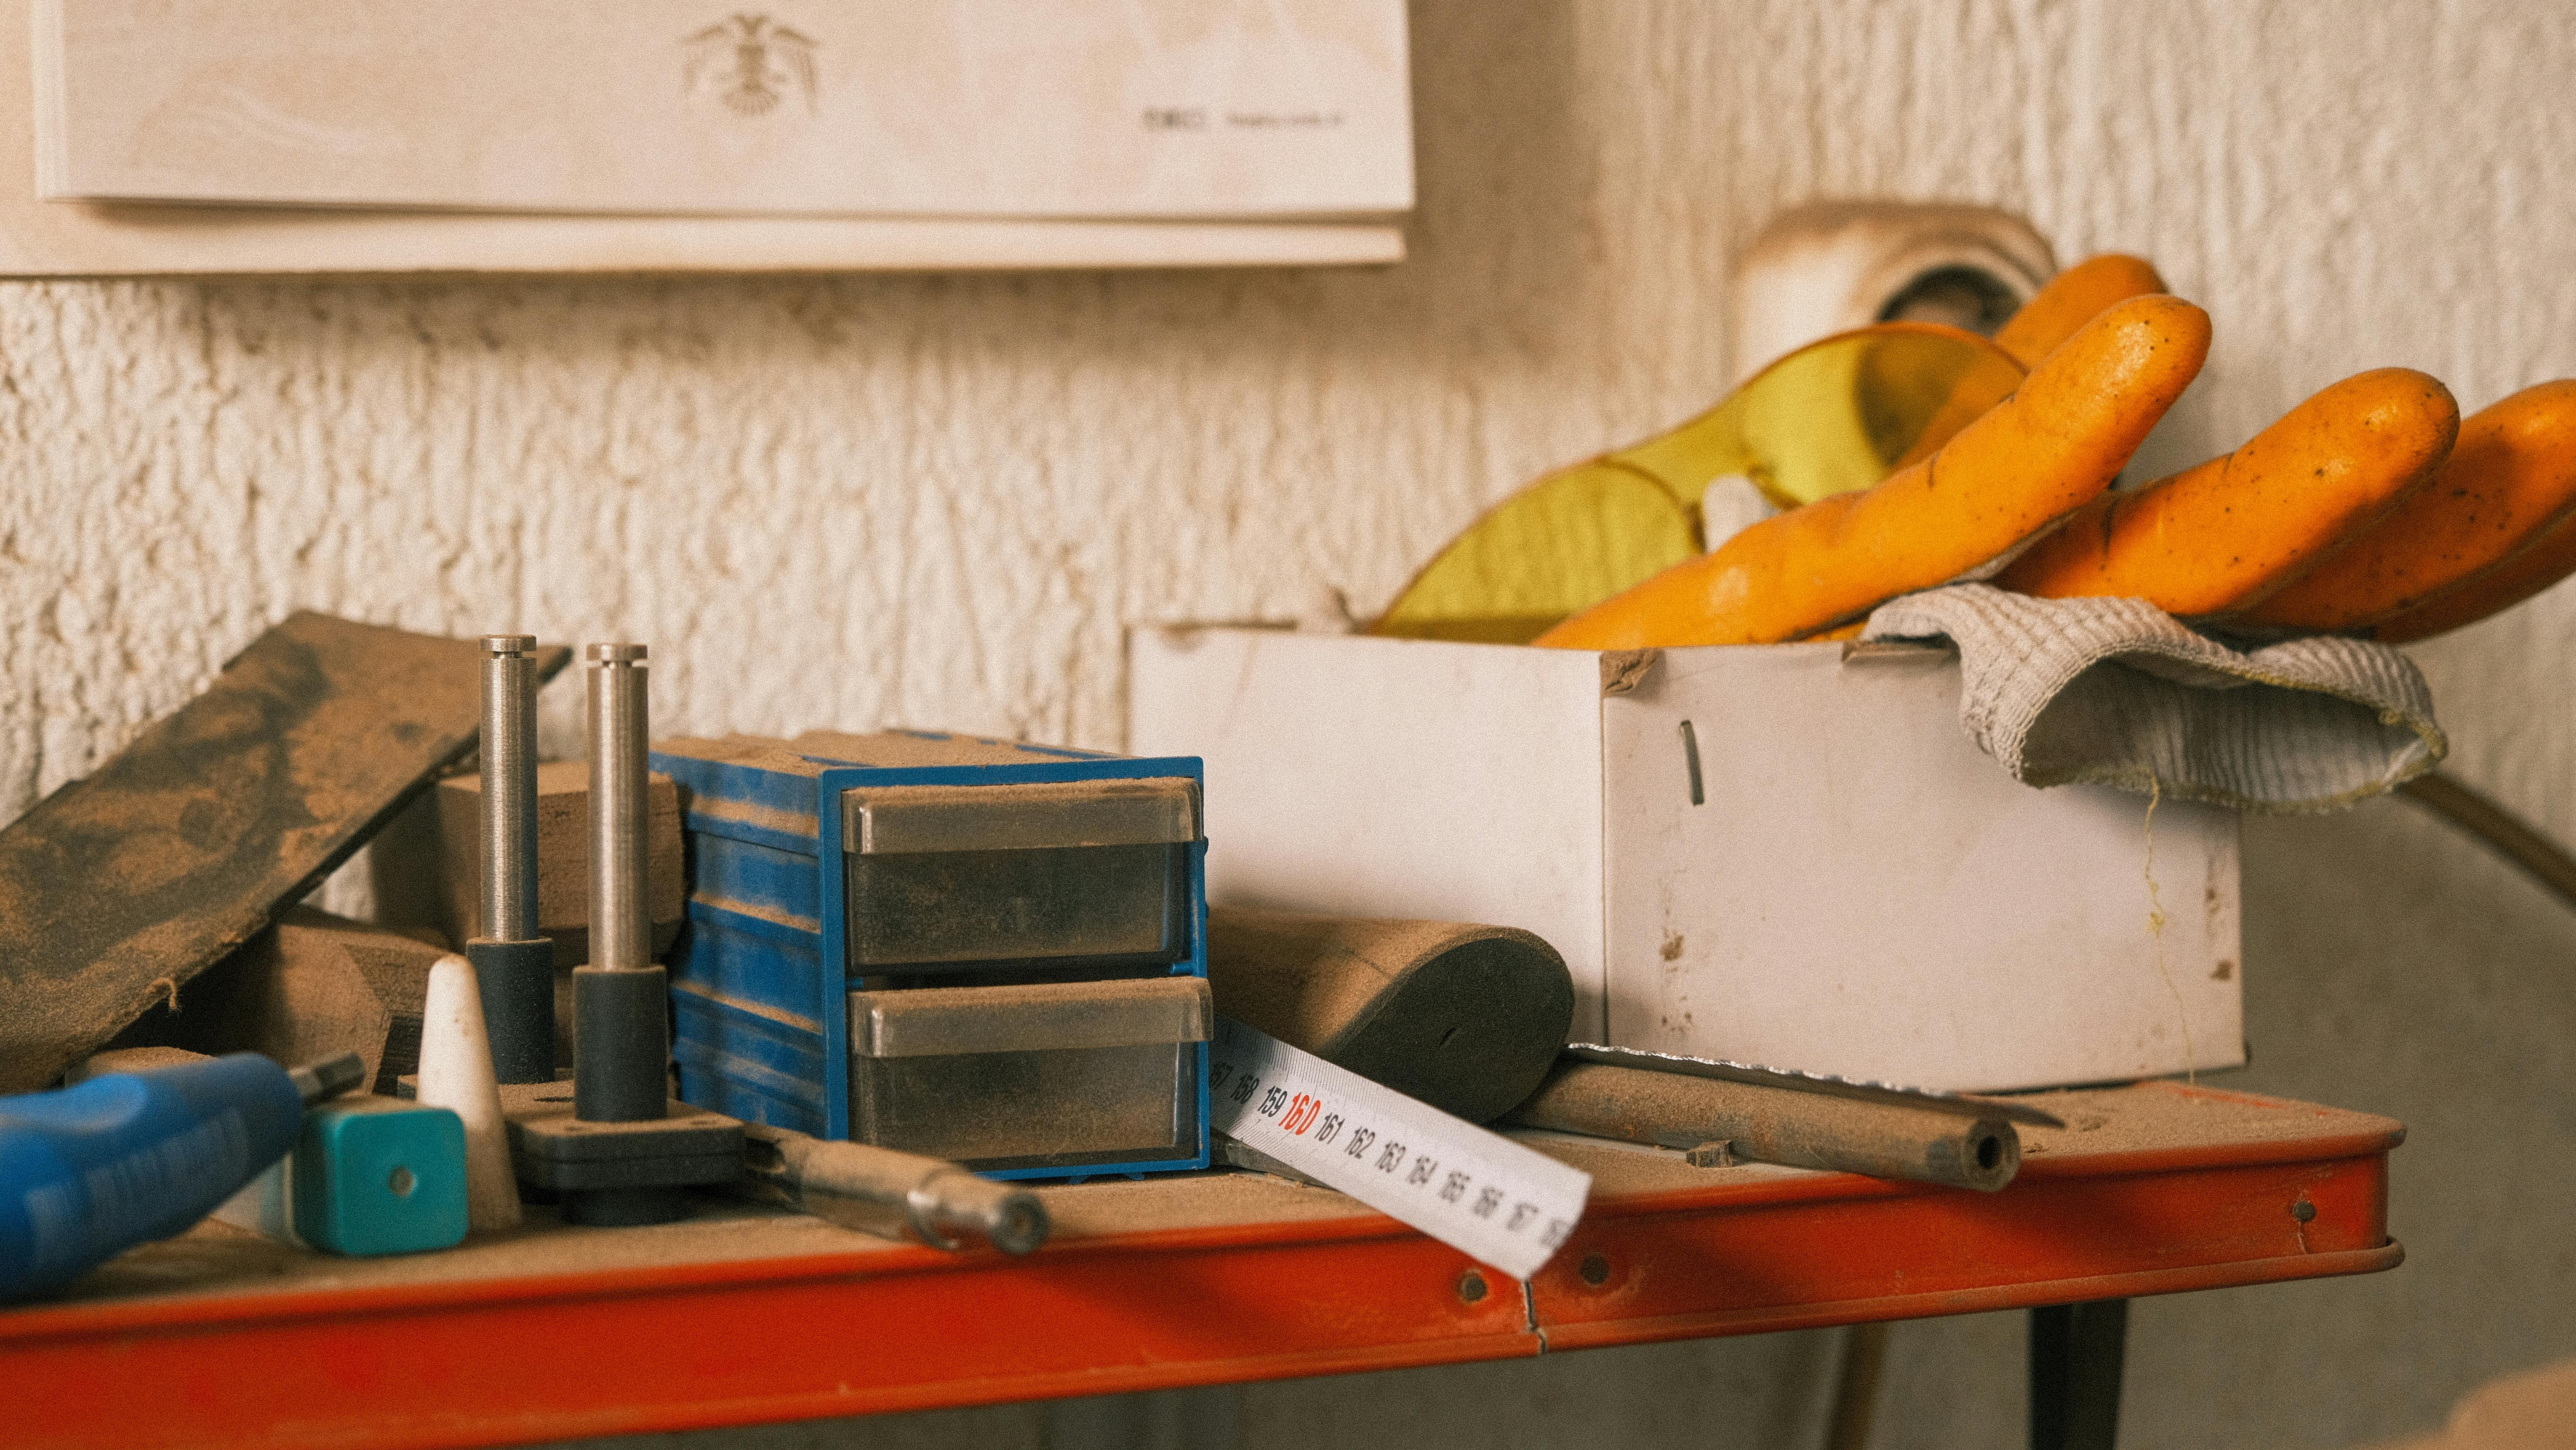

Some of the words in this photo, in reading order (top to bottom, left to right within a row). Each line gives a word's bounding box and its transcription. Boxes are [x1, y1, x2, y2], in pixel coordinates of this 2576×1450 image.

[1230, 1073, 1260, 1104] 158
[1257, 1085, 1287, 1117] 159
[1278, 1092, 1321, 1135] 160
[1314, 1112, 1345, 1144] 161
[1344, 1127, 1375, 1159] 162
[1375, 1141, 1406, 1173] 163
[1406, 1155, 1438, 1185] 164
[1438, 1170, 1472, 1203] 165
